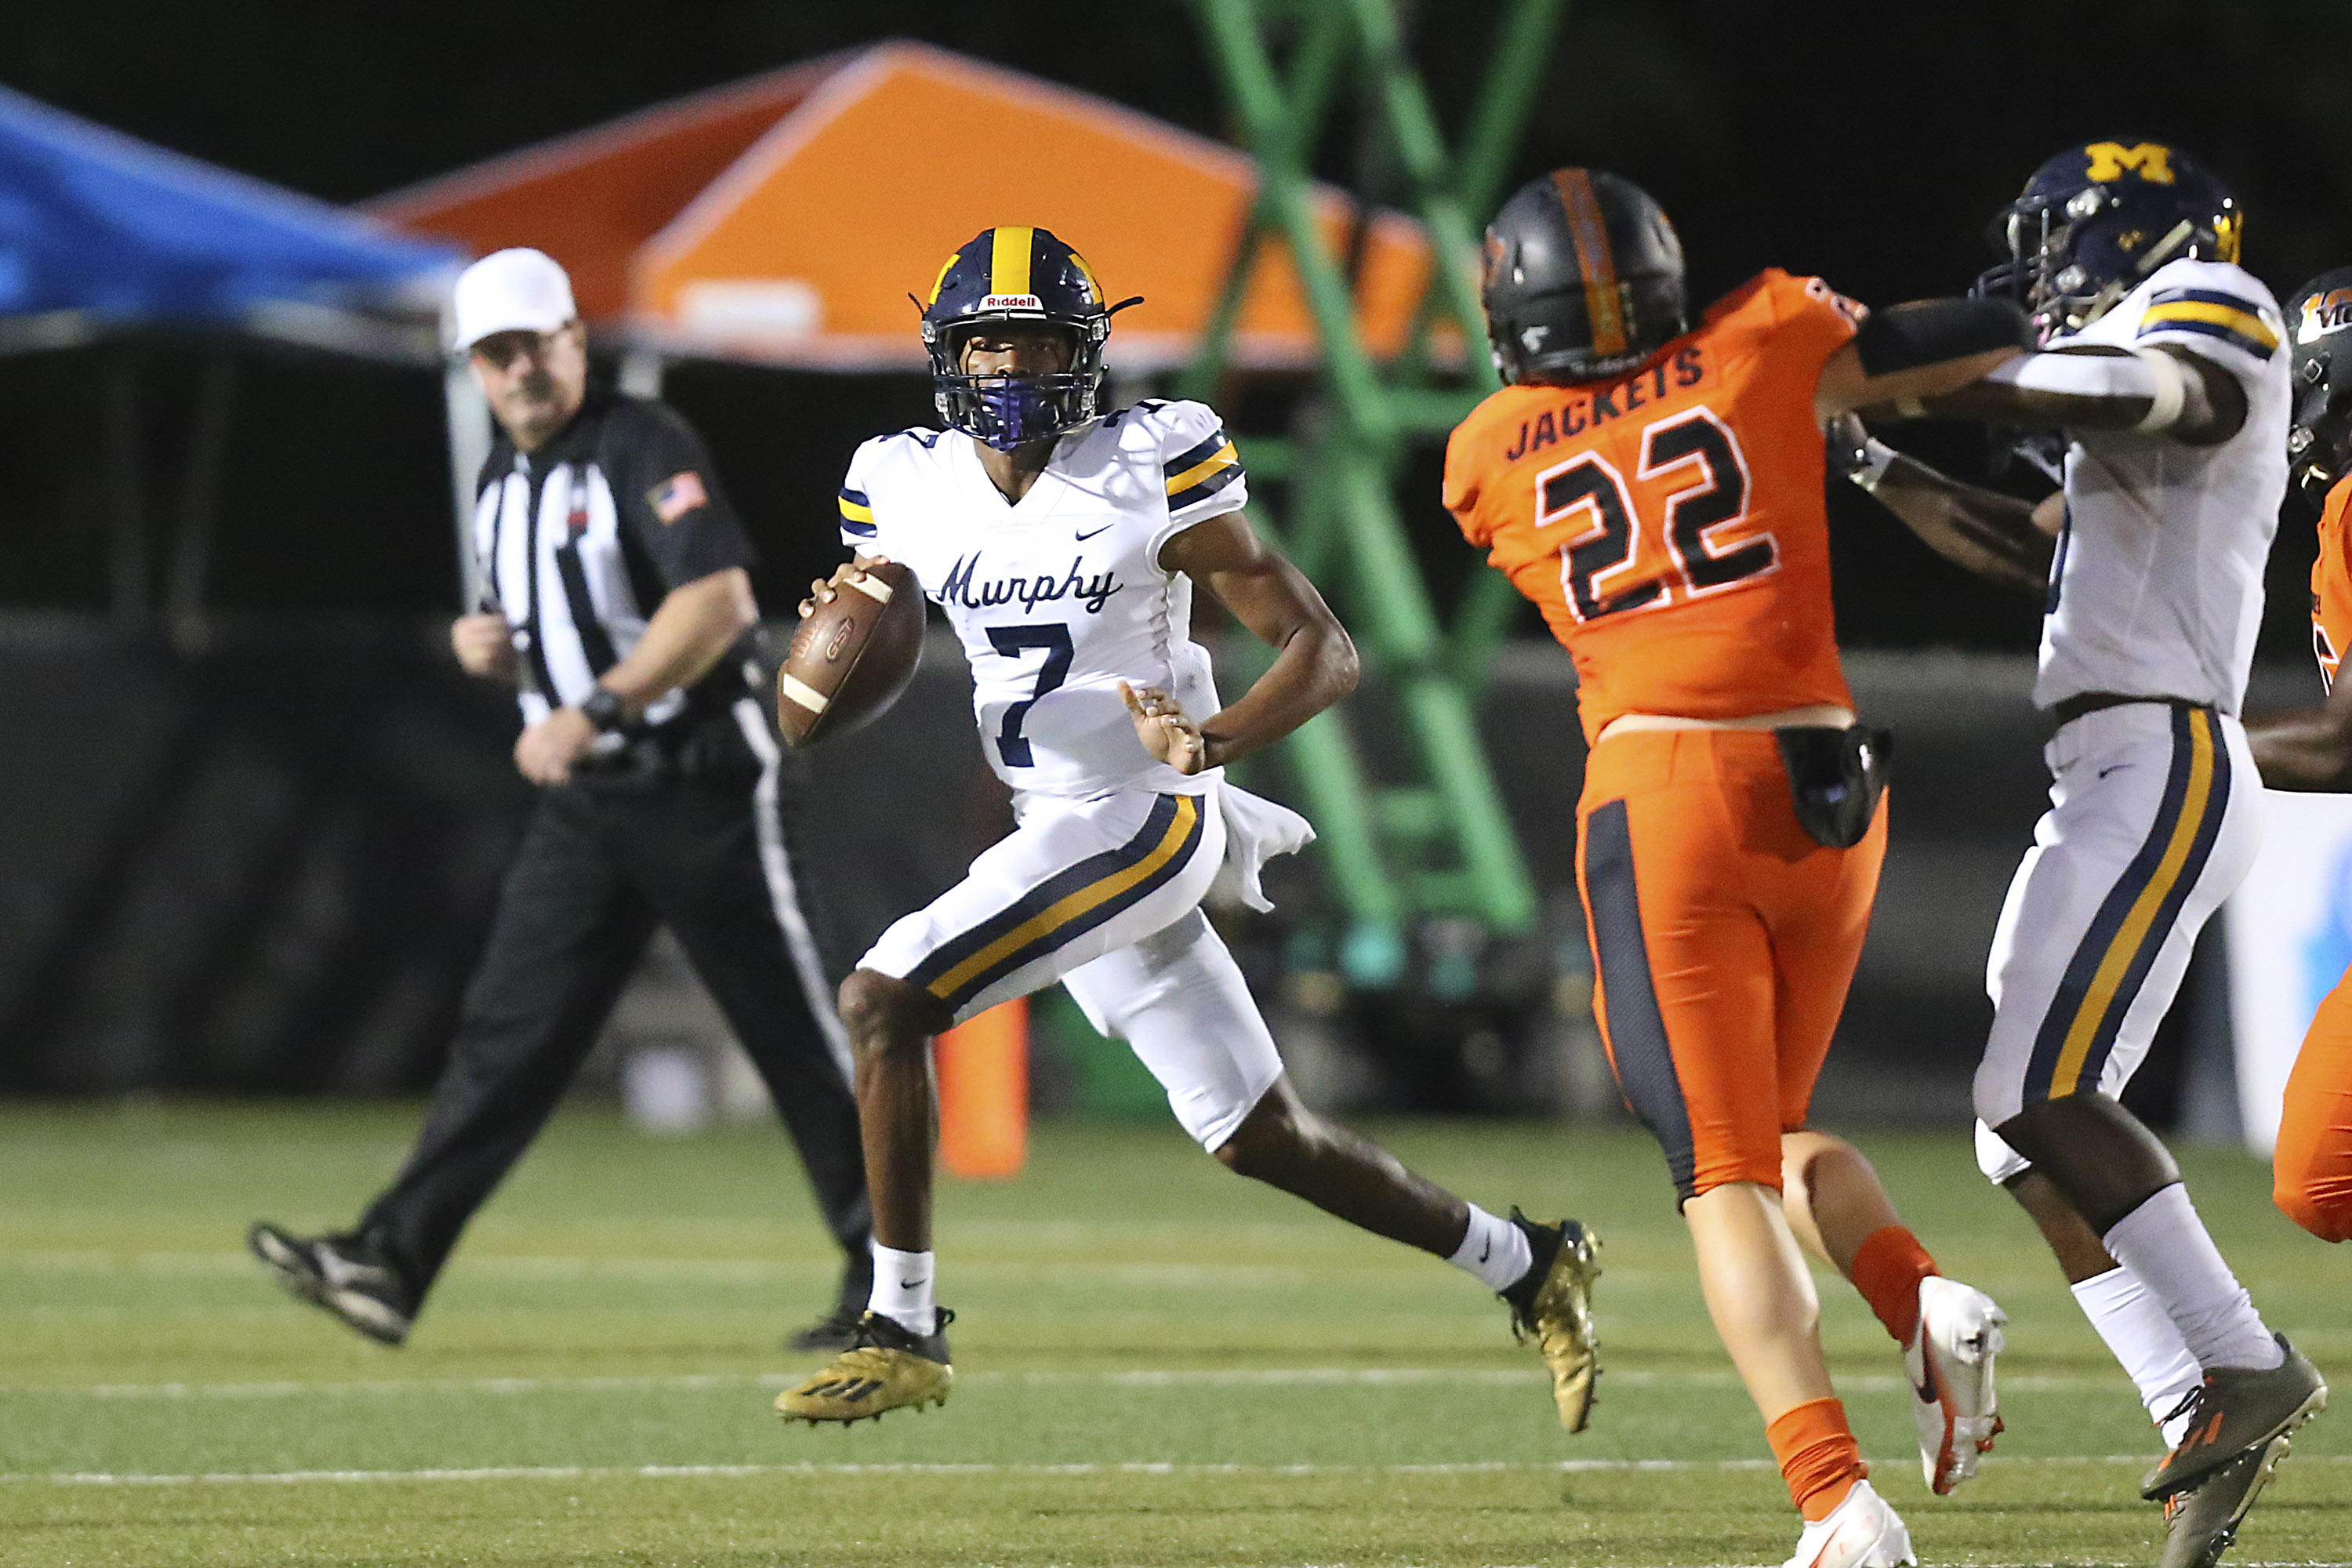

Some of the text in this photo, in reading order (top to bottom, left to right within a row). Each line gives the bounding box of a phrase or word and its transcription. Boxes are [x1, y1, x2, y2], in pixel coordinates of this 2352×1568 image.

[2085, 141, 2176, 185] M
[987, 297, 1036, 307] Riddell
[1506, 347, 1704, 462] JACKETS
[1534, 404, 1782, 624] 22
[935, 550, 1124, 615] Murphy
[984, 622, 1075, 768] 7
